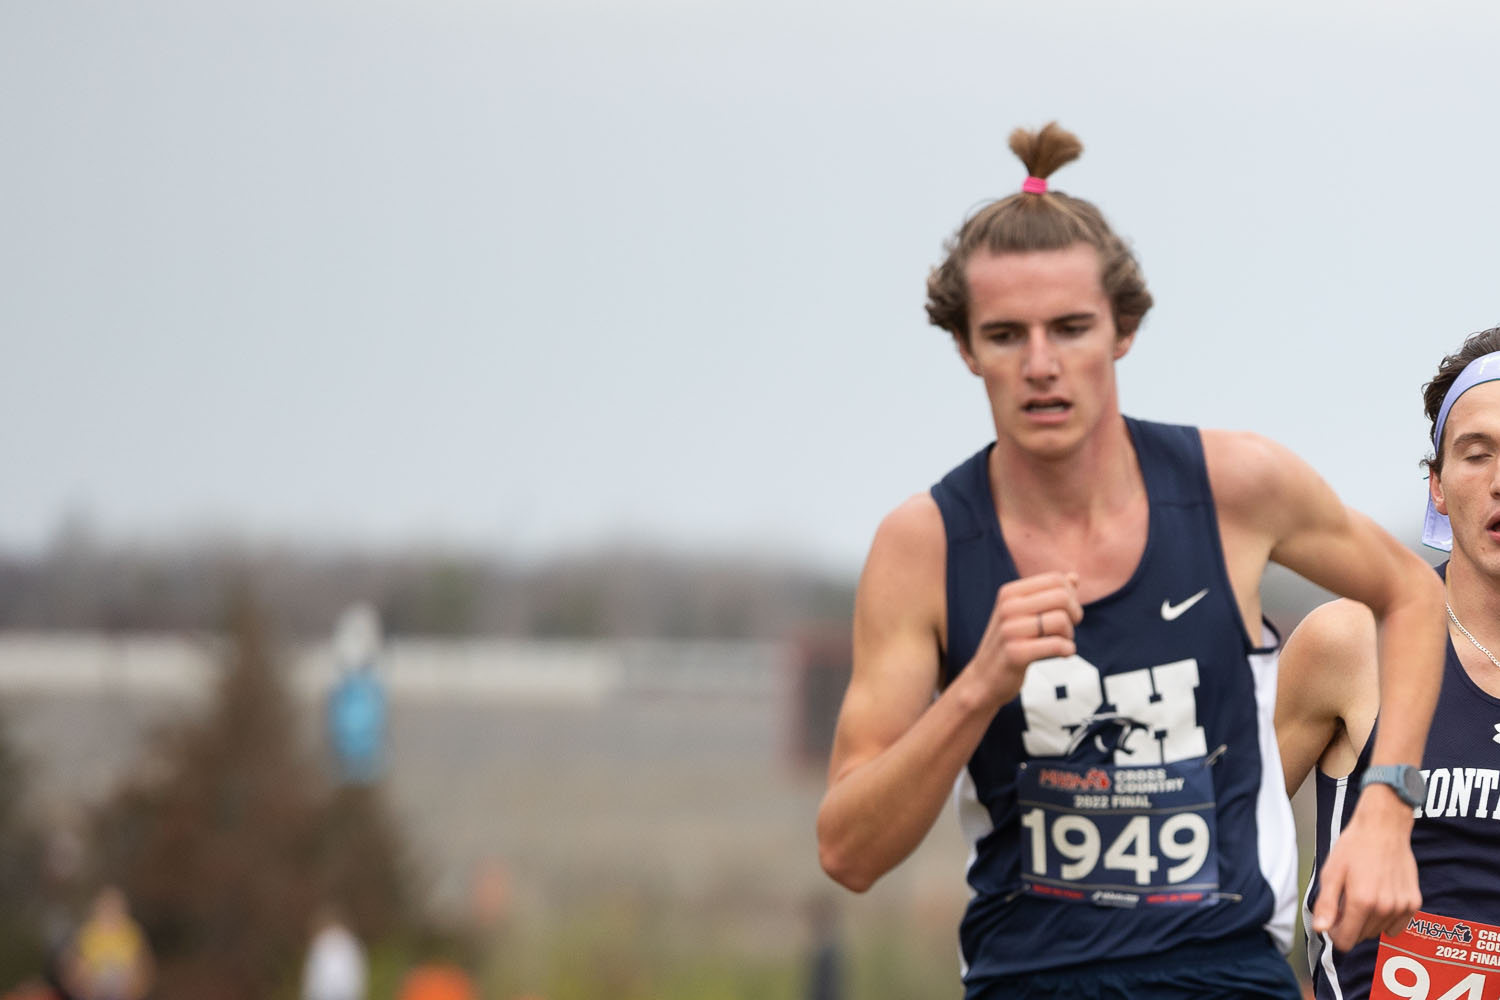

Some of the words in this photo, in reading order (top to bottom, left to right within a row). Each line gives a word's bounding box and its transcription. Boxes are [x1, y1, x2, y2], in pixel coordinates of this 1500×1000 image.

[1114, 778, 1185, 793] COUNTRY
[1111, 795, 1152, 808] FINAL
[1022, 808, 1210, 885] 1949
[1407, 917, 1464, 942] MHSAA
[1435, 945, 1467, 961] 2022
